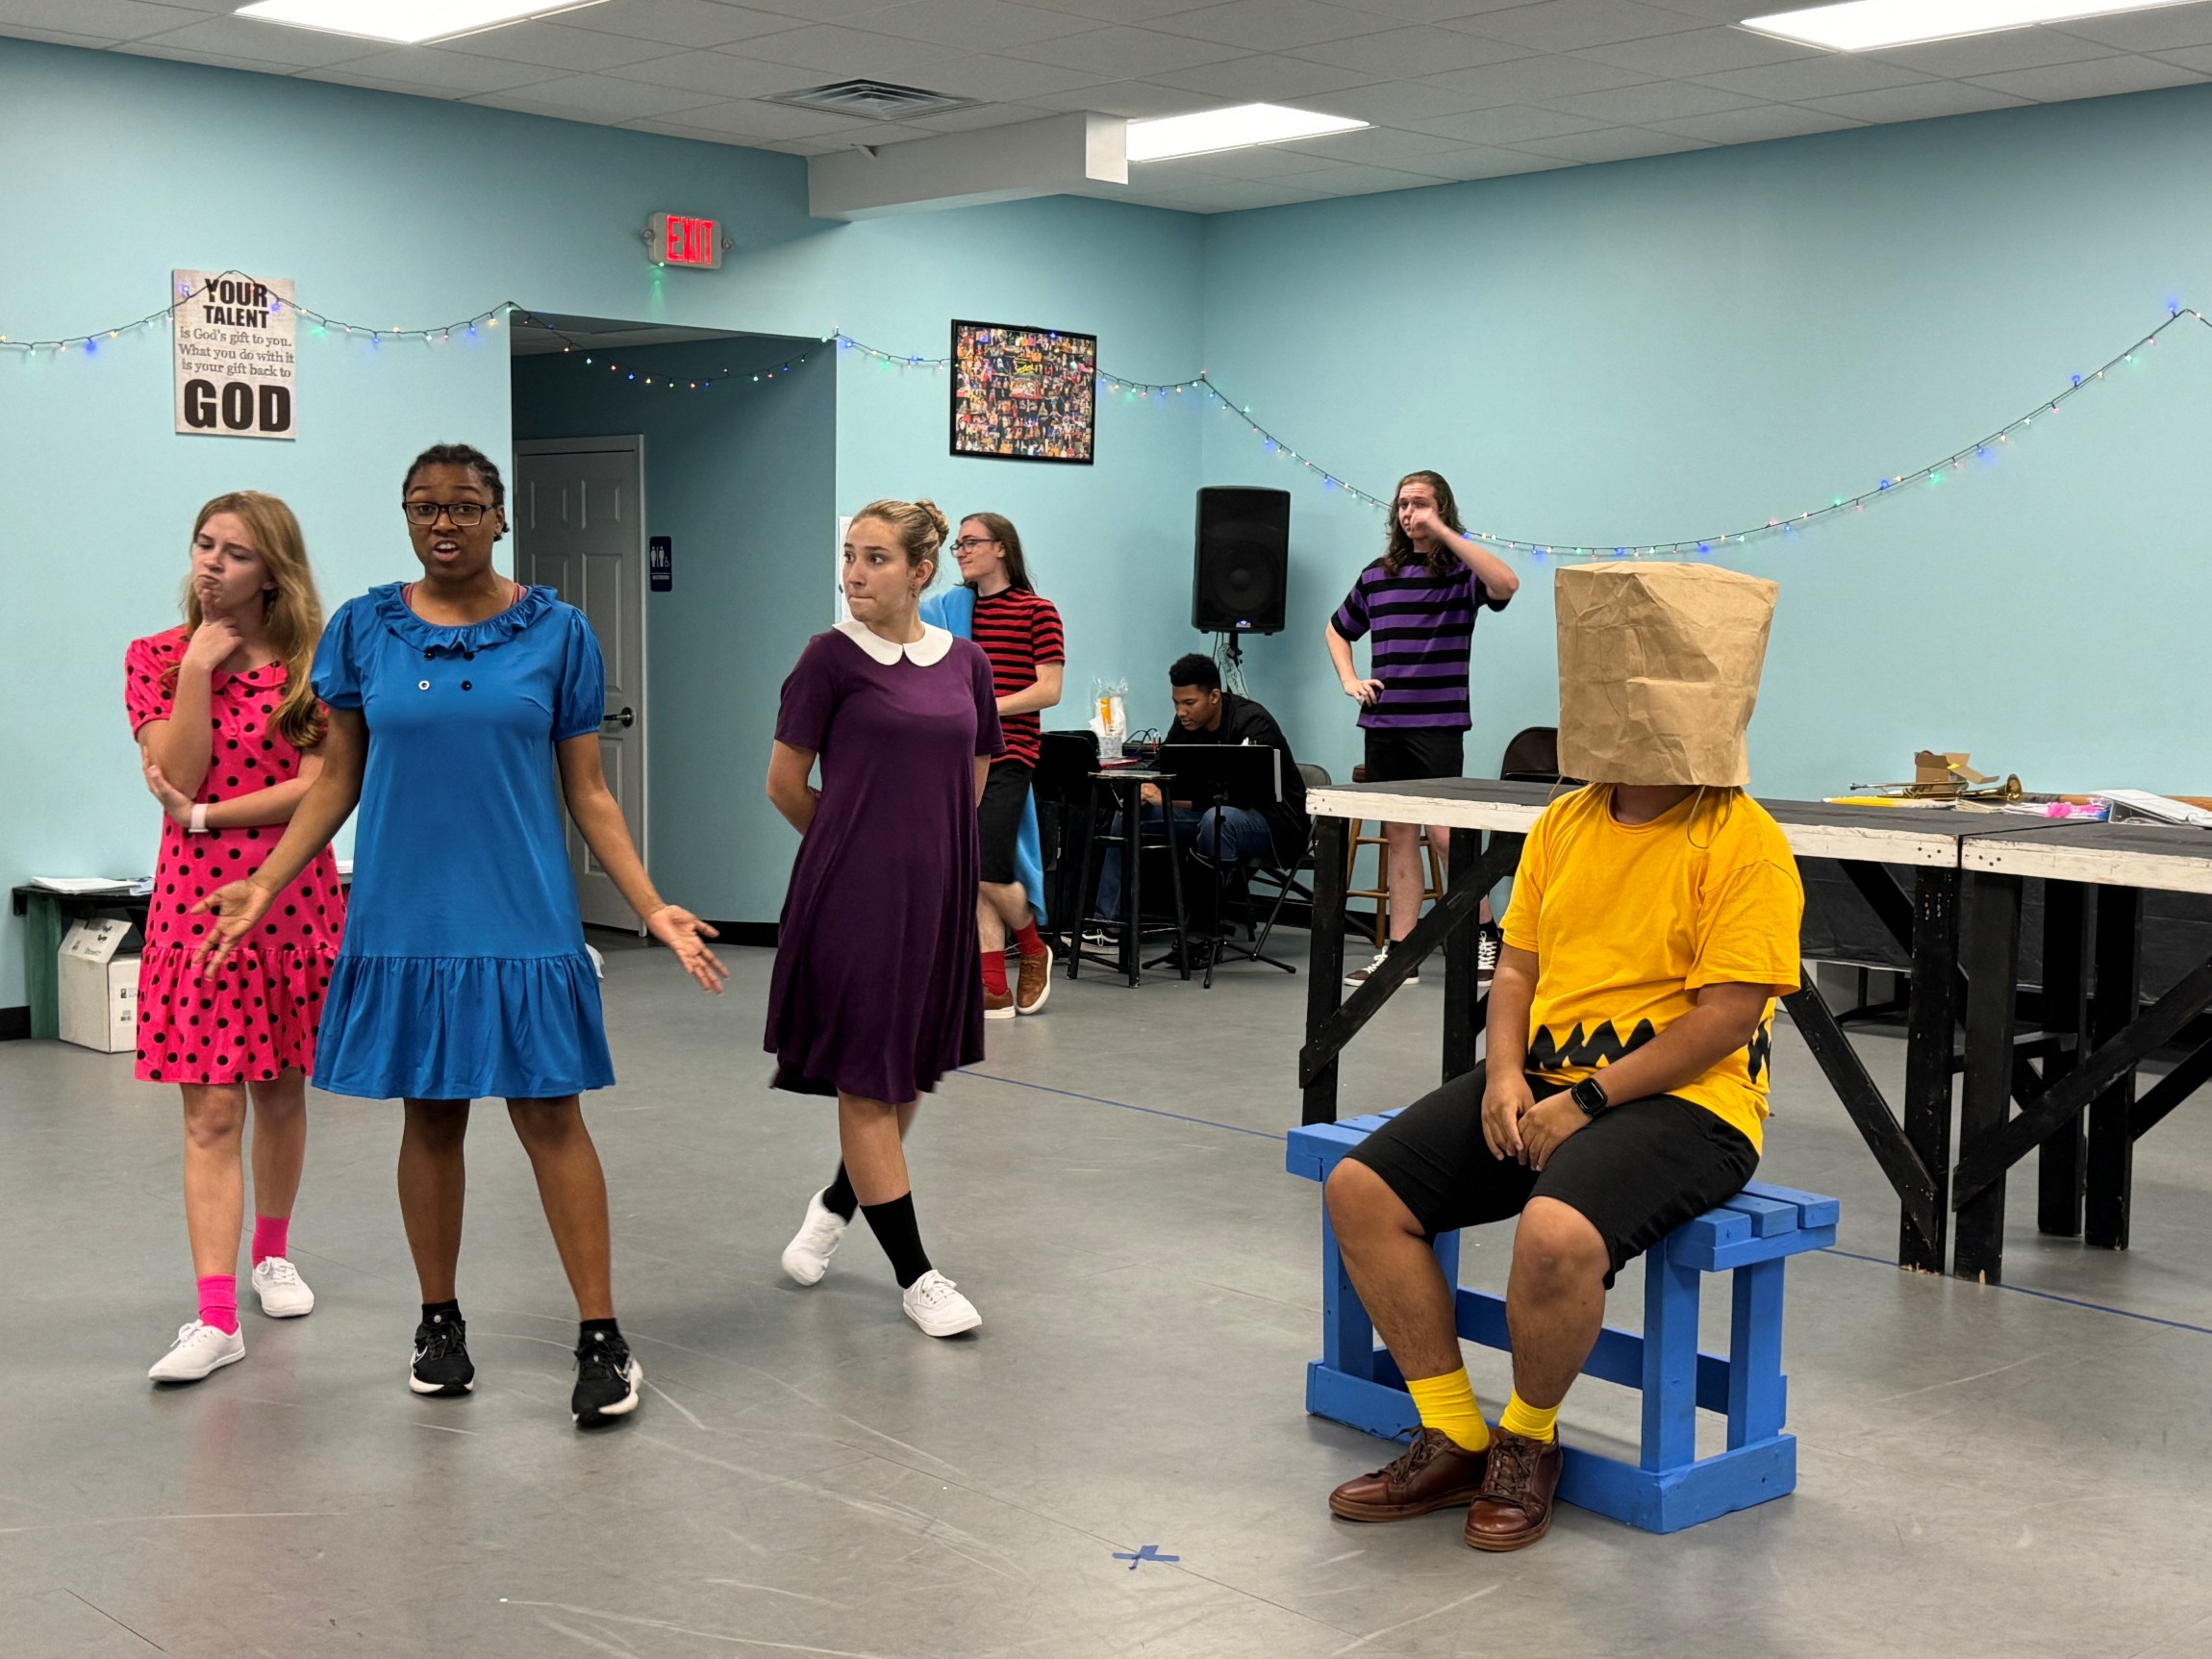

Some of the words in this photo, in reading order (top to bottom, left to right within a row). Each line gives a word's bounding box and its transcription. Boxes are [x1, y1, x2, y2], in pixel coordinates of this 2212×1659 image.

[666, 215, 715, 264] EXIT
[204, 278, 268, 308] YOUR
[203, 305, 269, 329] TALENT
[180, 327, 190, 339] is
[193, 328, 227, 341] God's
[230, 332, 249, 346] gift
[252, 335, 264, 345] to
[265, 338, 291, 347] you.
[179, 343, 211, 357] What
[214, 350, 236, 361] you
[239, 349, 254, 360] do
[256, 351, 283, 363] with
[286, 352, 294, 364] it
[182, 359, 192, 370] is
[194, 363, 224, 373] your
[227, 363, 246, 376] gift
[250, 365, 278, 377] back
[280, 367, 291, 378] to
[184, 379, 291, 432] GOD
